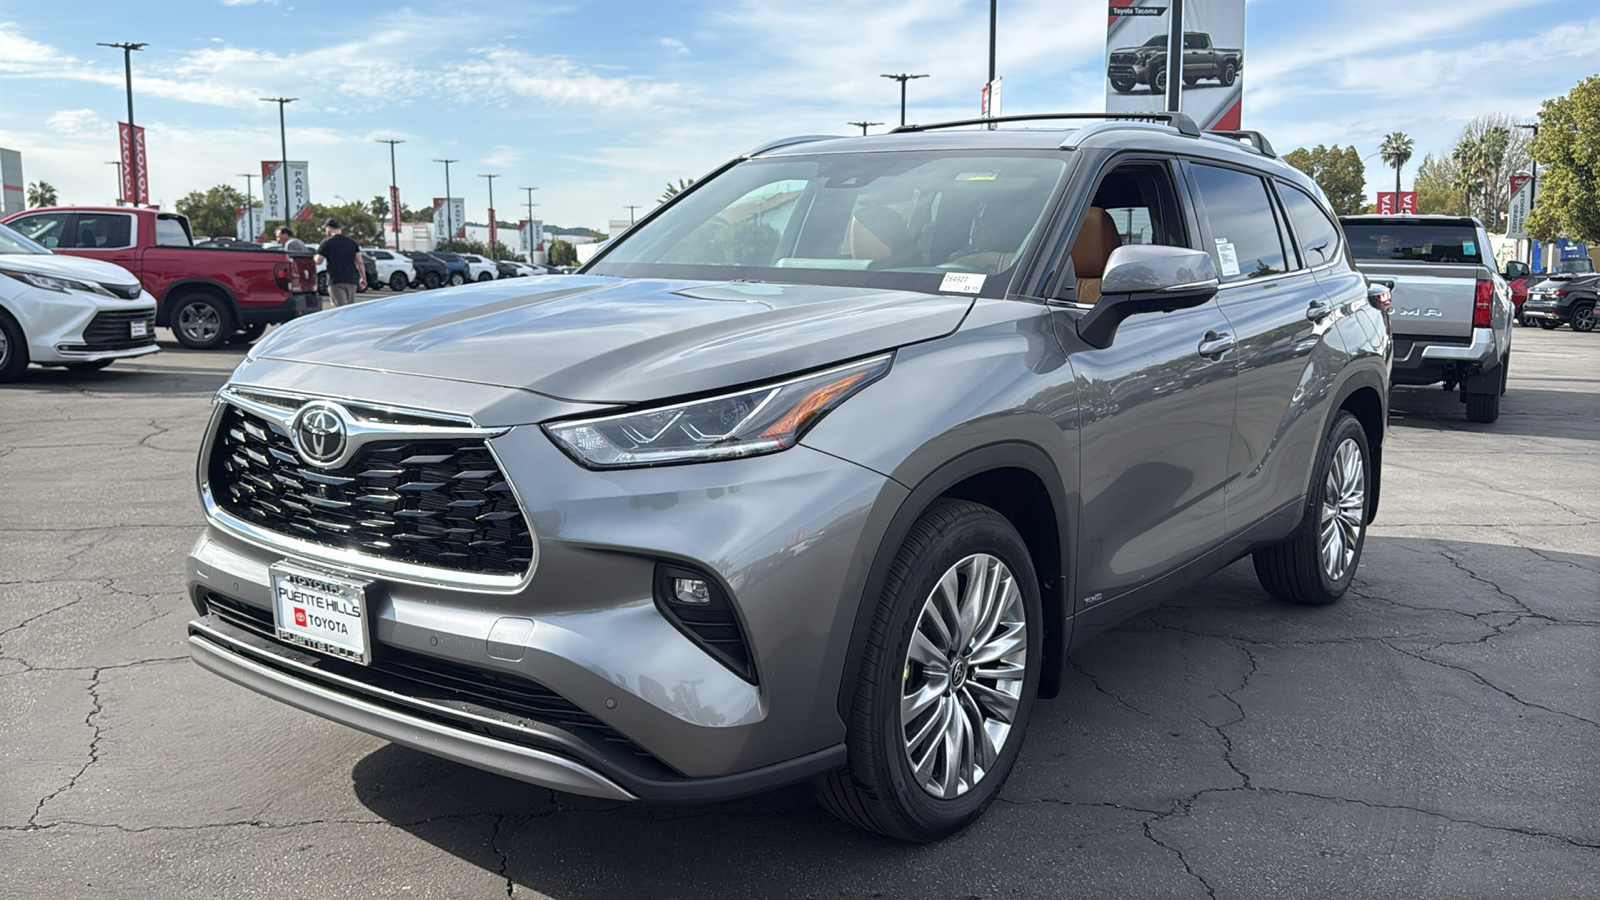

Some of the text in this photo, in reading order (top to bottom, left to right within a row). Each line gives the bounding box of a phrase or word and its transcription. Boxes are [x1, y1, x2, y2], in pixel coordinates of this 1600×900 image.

[1113, 7, 1133, 15] Toyota
[122, 128, 132, 198] TOYOTA
[136, 132, 147, 200] TOYOTA
[295, 171, 304, 211] PARKIN
[291, 575, 339, 593] TOYOTA
[278, 586, 361, 618] PUENTE HILLS
[308, 614, 349, 635] TOYOTA
[280, 631, 361, 661] PUENTE HILLS
